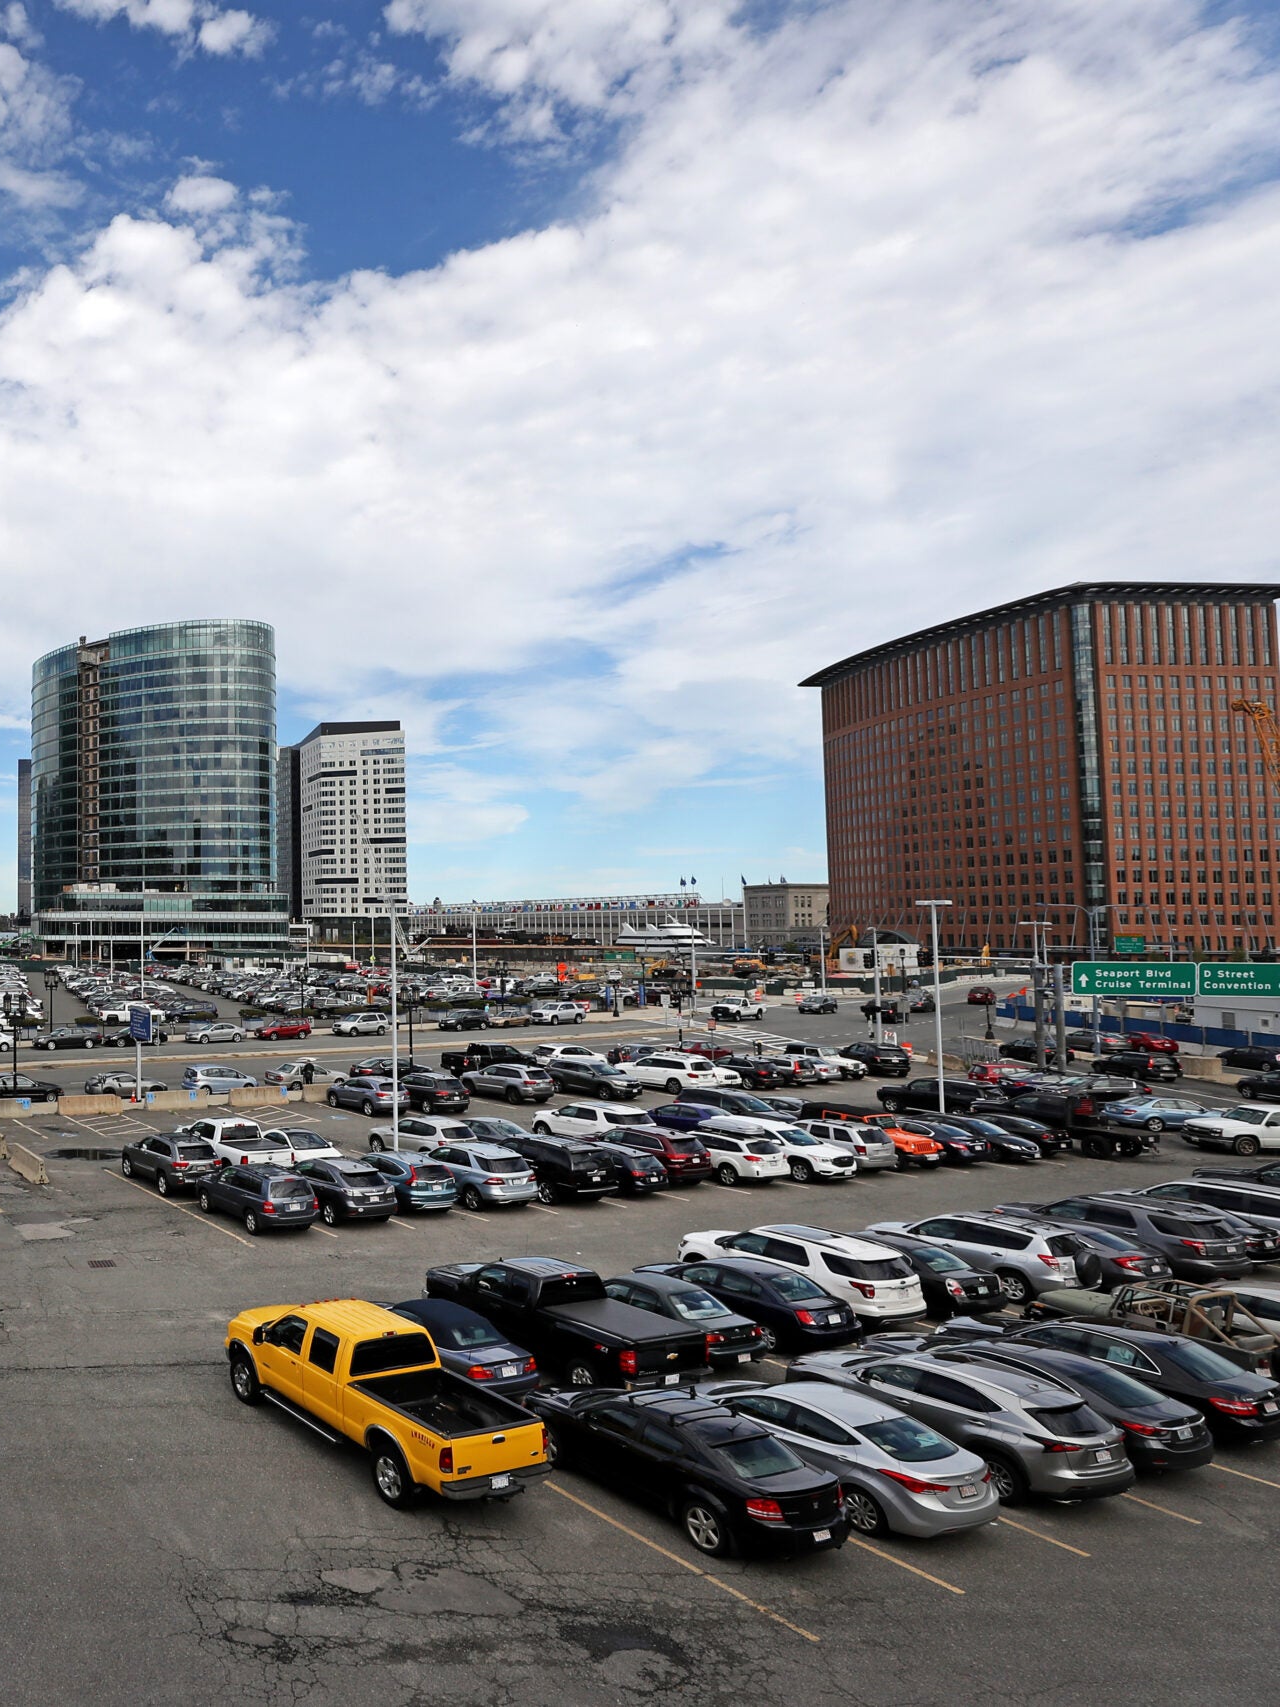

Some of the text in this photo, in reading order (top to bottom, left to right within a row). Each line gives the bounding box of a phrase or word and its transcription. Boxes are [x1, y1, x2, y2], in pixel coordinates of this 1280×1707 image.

[1095, 969, 1172, 978] Seaport Blvd
[1203, 970, 1255, 979] D Street
[1095, 980, 1191, 989] Cruise Terminal
[1203, 981, 1272, 990] Convention
